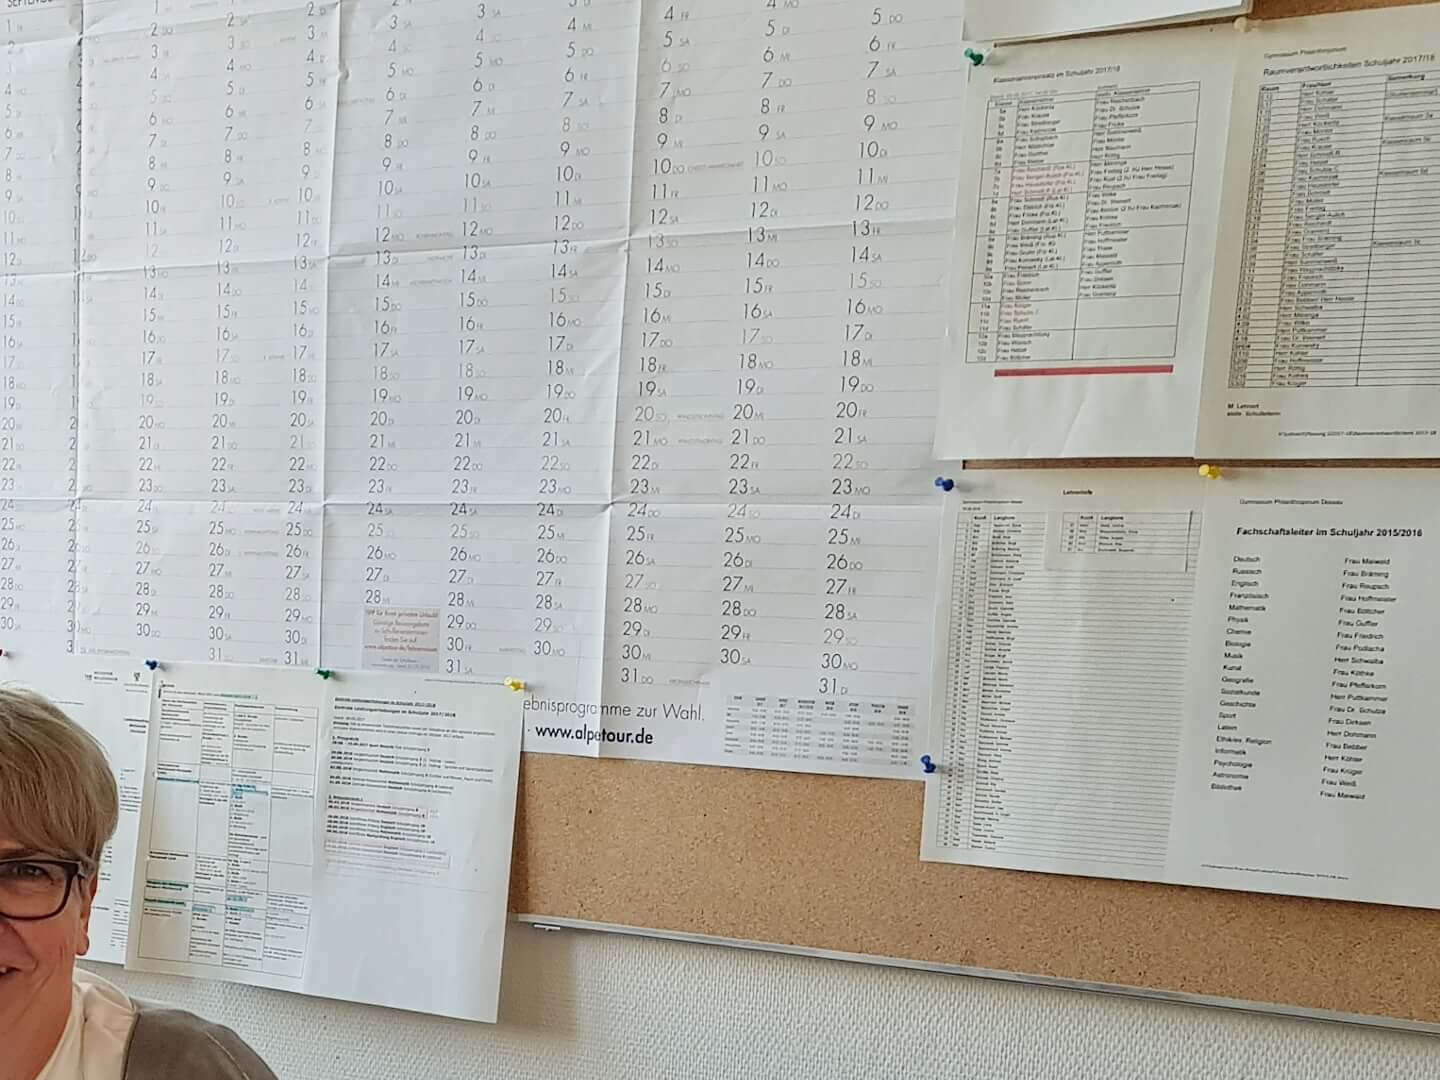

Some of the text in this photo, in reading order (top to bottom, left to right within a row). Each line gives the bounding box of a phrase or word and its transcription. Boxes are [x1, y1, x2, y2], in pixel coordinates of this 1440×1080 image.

[664, 6, 673, 21] 4
[872, 8, 881, 25] 5
[568, 17, 576, 31] 4
[765, 19, 775, 36] 5
[869, 35, 880, 52] 6
[475, 52, 482, 68] 5
[388, 62, 396, 78] 5
[867, 61, 879, 78] 7
[762, 72, 773, 88] 7
[761, 98, 769, 114] 8
[864, 115, 875, 132] 9
[471, 125, 479, 140] 8
[861, 141, 878, 158] 10
[655, 158, 671, 175] 10
[755, 176, 767, 192] 11
[859, 168, 873, 184] 11
[752, 201, 768, 218] 12
[857, 194, 874, 211] 12
[376, 227, 390, 242] 12
[463, 221, 478, 236] 12
[749, 227, 765, 243] 13
[853, 220, 870, 237] 13
[852, 246, 868, 263] 14
[648, 258, 663, 273] 14
[848, 298, 866, 315] 16
[741, 353, 756, 370] 18
[844, 350, 860, 367] 18
[842, 376, 859, 392] 19
[836, 402, 857, 418] 20
[370, 434, 384, 448] 21
[455, 432, 469, 448] 21
[634, 430, 649, 446] 21
[732, 429, 748, 445] 21
[834, 427, 851, 444] 21
[212, 457, 226, 471] 22
[289, 479, 304, 493] 23
[539, 479, 556, 493] 23
[631, 478, 648, 494] 23
[832, 478, 852, 495] 23
[830, 504, 851, 519] 24
[725, 527, 744, 543] 25
[828, 528, 848, 544] 25
[1237, 528, 1313, 536] Fachschaftsleiter
[1330, 529, 1374, 538] Schuljahr
[1377, 529, 1422, 537] 2015/2016
[1, 557, 14, 570] 27
[136, 561, 150, 575] 27
[827, 554, 848, 570] 26
[286, 565, 301, 579] 27
[449, 569, 467, 583] 27
[537, 571, 554, 586] 27
[826, 578, 847, 595] 27
[366, 590, 381, 604] 28
[624, 597, 642, 613] 28
[136, 603, 150, 616] 29
[722, 600, 741, 616] 28
[824, 603, 845, 620] 28
[210, 626, 223, 640] 30
[285, 630, 300, 644] 30
[534, 640, 551, 655] 30
[720, 648, 740, 664] 30
[821, 653, 842, 669] 30
[446, 659, 460, 673] 31
[621, 668, 637, 683] 31
[819, 678, 836, 694] 31
[636, 705, 656, 718] zur
[663, 704, 704, 721] Wahl.
[535, 723, 653, 744] www.alpetour.de
